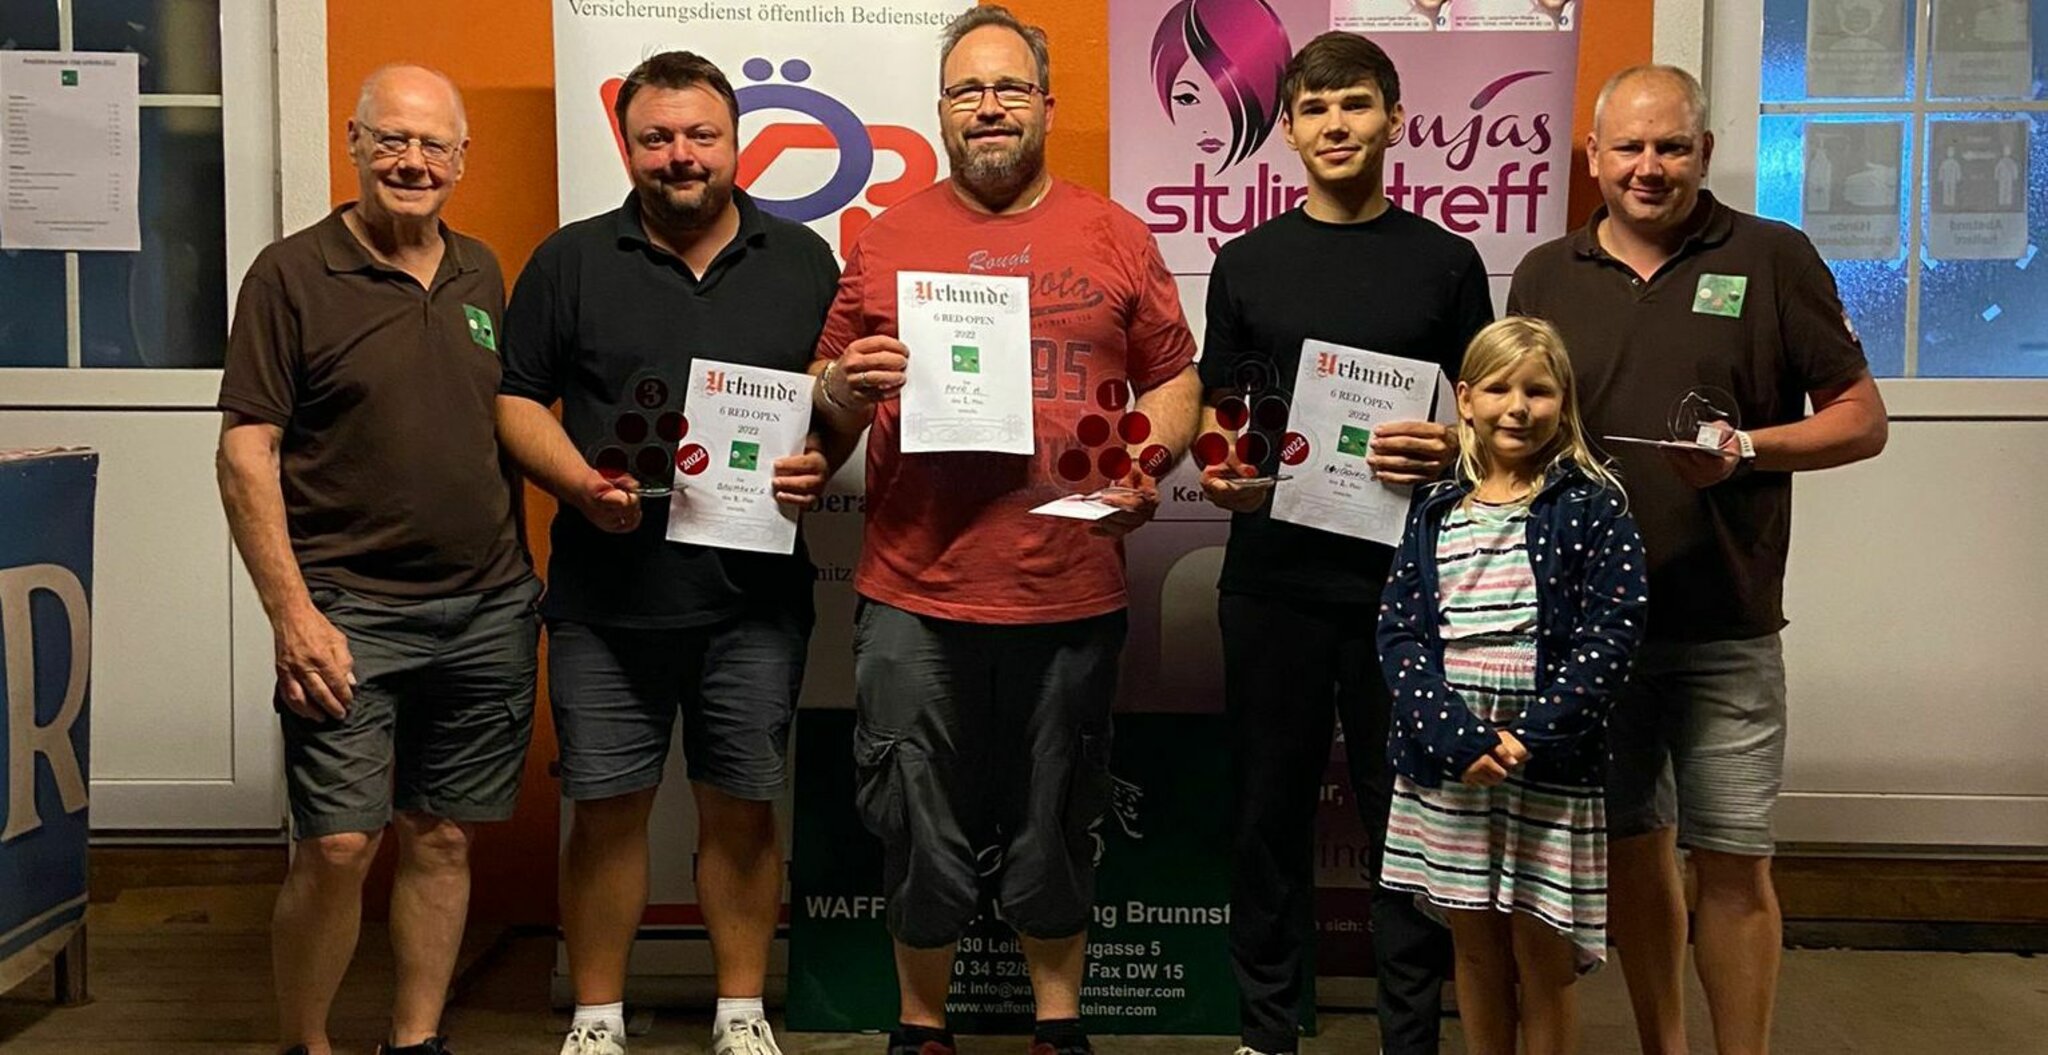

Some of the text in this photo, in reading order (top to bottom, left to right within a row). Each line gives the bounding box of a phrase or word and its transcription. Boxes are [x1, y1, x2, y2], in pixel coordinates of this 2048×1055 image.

[568, 0, 958, 27] Versicherungsdienst öffentlich Bedienstete
[968, 243, 1032, 273] Rough
[914, 280, 1009, 306] Urkunde
[933, 313, 995, 325] 6 RED OPEN
[954, 329, 976, 339] 2022
[1316, 352, 1415, 391] Urkunde
[643, 379, 661, 407] 3
[705, 370, 797, 403] Urkunde
[1330, 390, 1394, 410] 6 RED OPEN
[719, 407, 781, 422] 6 RED OPEN
[1348, 410, 1371, 421] 2022
[737, 425, 760, 435] 2022
[680, 448, 707, 471] 2022
[1280, 436, 1306, 461] 2022
[805, 895, 886, 920] WAFF
[1150, 940, 1161, 956] 5
[969, 959, 990, 977] 34
[1088, 962, 1121, 979] Fax
[1126, 962, 1158, 980] DW
[1163, 963, 1185, 980] 15
